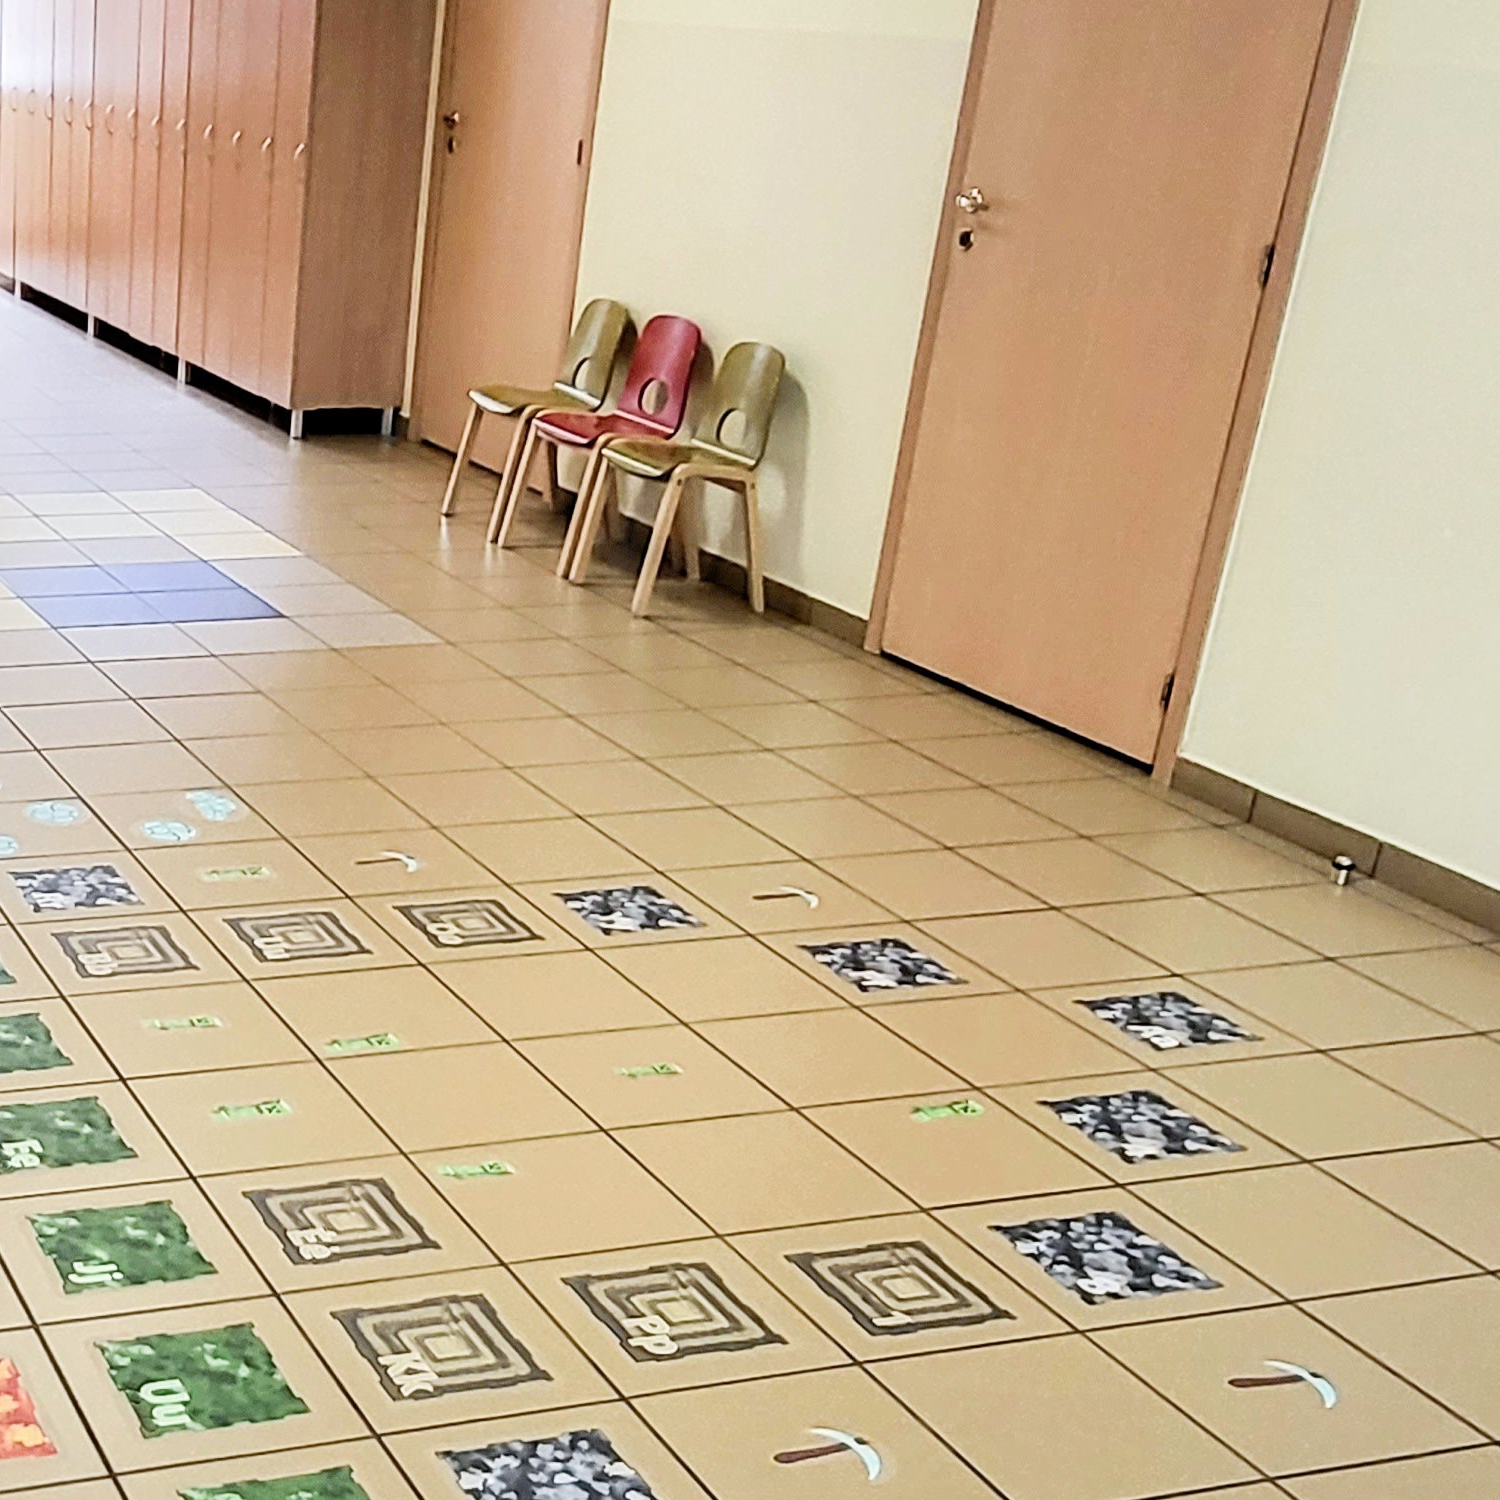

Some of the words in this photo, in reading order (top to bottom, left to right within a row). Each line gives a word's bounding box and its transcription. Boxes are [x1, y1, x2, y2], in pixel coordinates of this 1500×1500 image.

[67, 1261, 125, 1284] Jj
[871, 1310, 912, 1327] 1
[621, 1315, 678, 1355] Pp
[377, 1352, 439, 1397] Kk
